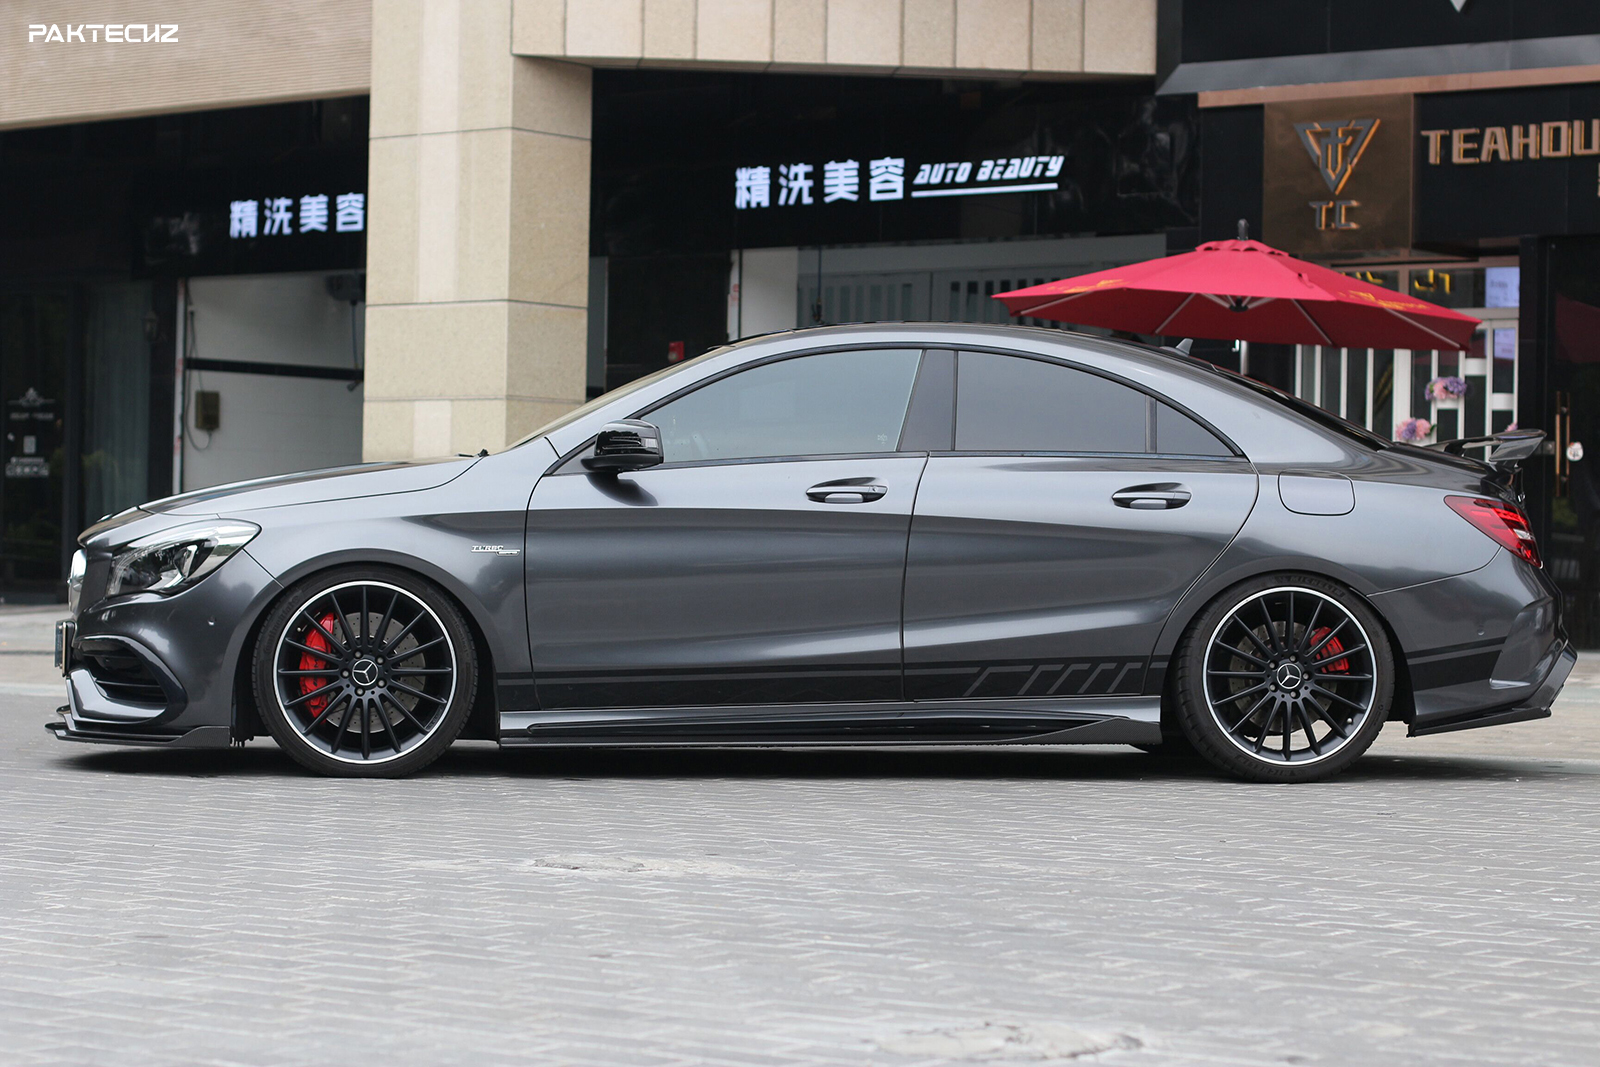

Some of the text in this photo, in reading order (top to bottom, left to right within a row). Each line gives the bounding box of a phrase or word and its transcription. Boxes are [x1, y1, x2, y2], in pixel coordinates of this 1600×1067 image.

[735, 156, 905, 209] 精洗美容
[912, 155, 1065, 185] AUTO BEAUTY
[229, 192, 365, 239] 精洗美容
